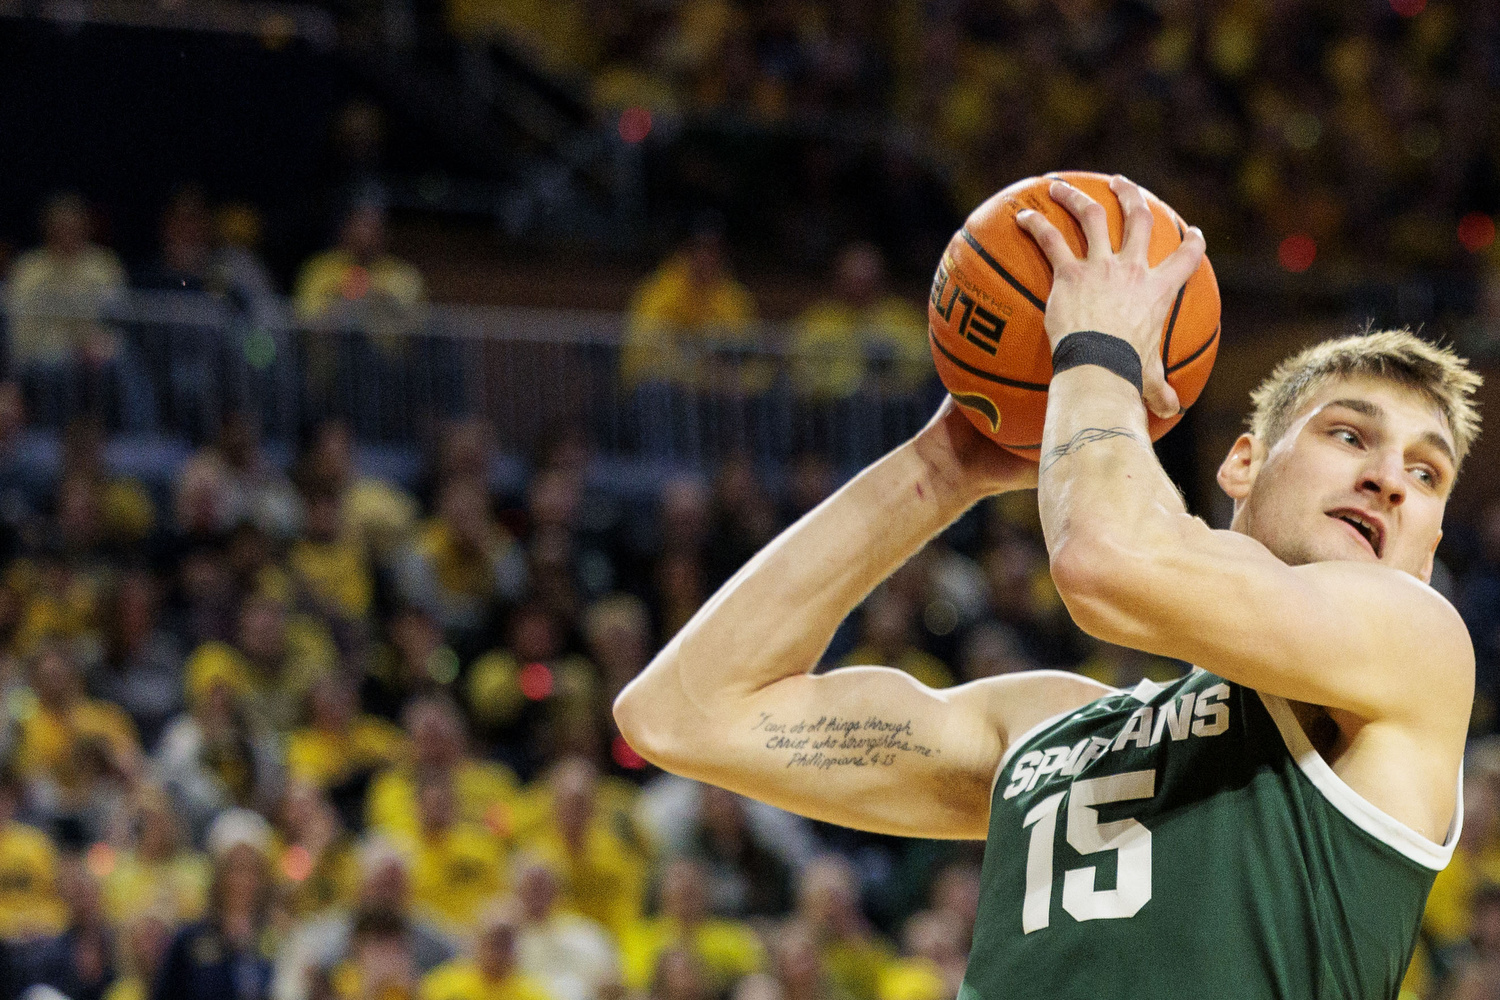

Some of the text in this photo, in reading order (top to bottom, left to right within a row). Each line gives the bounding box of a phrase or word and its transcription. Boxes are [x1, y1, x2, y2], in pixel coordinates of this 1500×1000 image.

[766, 735, 810, 750] Christ
[1002, 682, 1230, 800] SPARANS
[1022, 769, 1156, 935] 15
